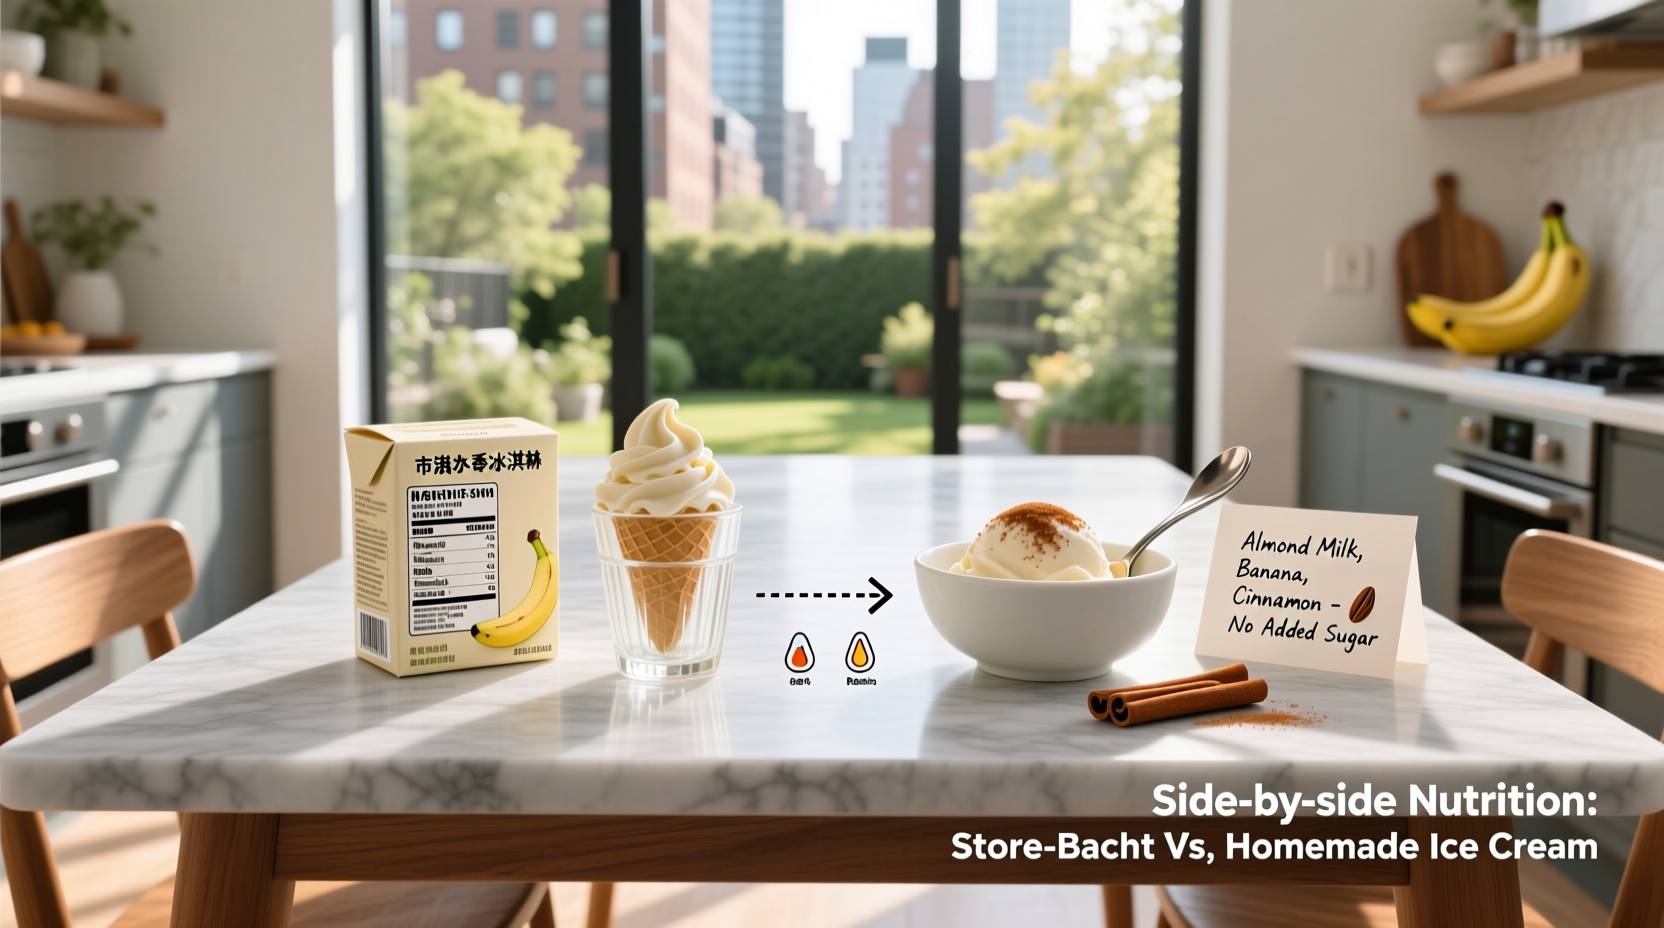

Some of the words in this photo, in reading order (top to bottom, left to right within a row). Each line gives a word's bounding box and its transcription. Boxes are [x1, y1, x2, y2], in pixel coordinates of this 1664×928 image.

[1240, 530, 1312, 556] Almond
[1315, 537, 1363, 564] Milk,
[1236, 557, 1308, 586] Banana,
[1232, 584, 1321, 611] Cinnamon
[1227, 614, 1254, 634] No
[1260, 616, 1319, 641] Added
[1324, 623, 1379, 654] Sugar
